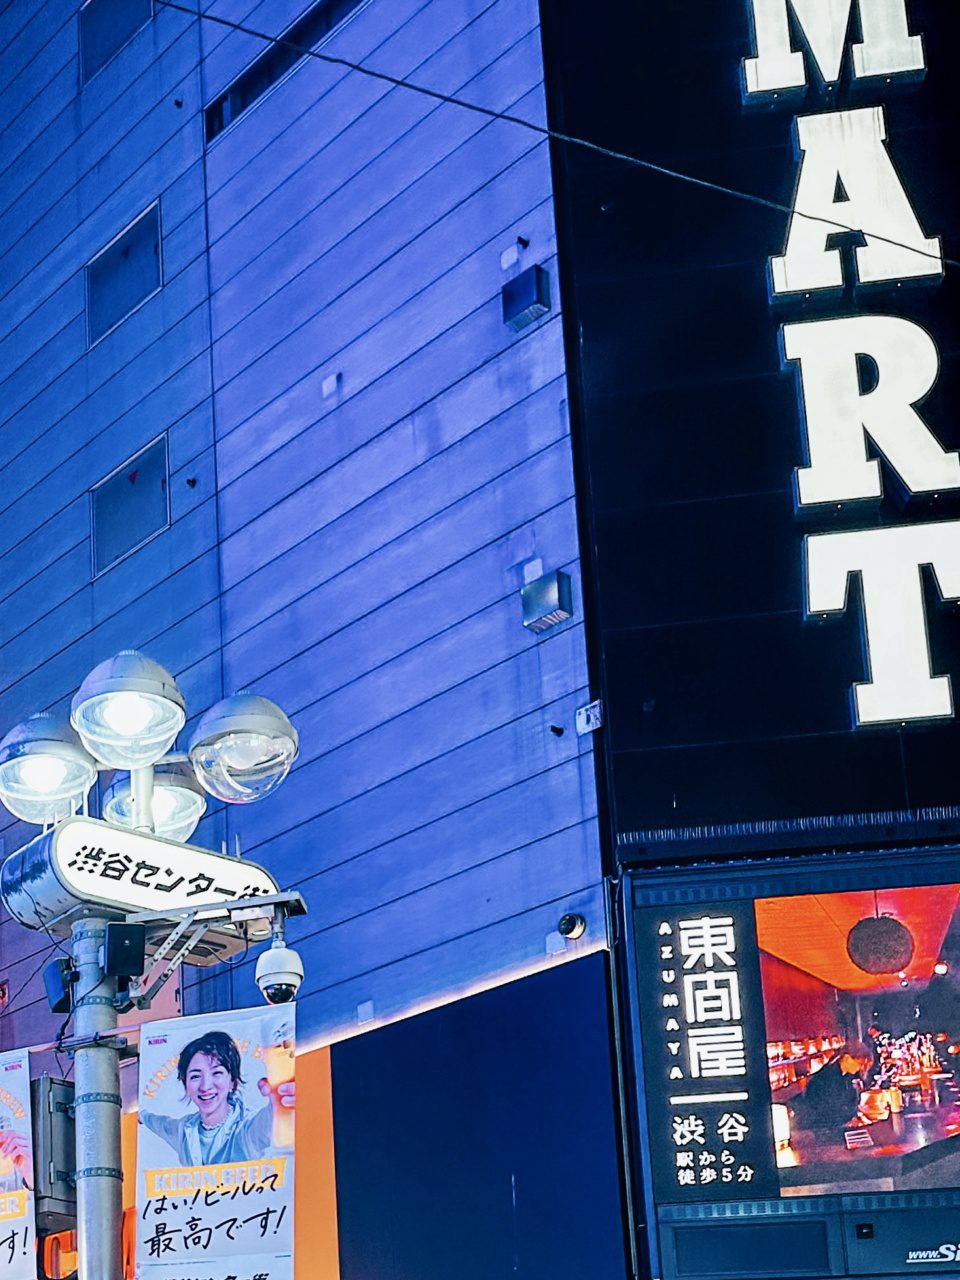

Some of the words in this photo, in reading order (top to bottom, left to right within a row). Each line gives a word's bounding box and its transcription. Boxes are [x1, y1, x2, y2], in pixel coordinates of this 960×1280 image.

[743, 0, 960, 727] MART
[658, 920, 685, 1081] AZUMAYA
[148, 1038, 168, 1046] KIRIN
[671, 1111, 750, 1147] 渋谷
[675, 1150, 736, 1168] 駅から
[154, 1171, 218, 1192] KIRIN
